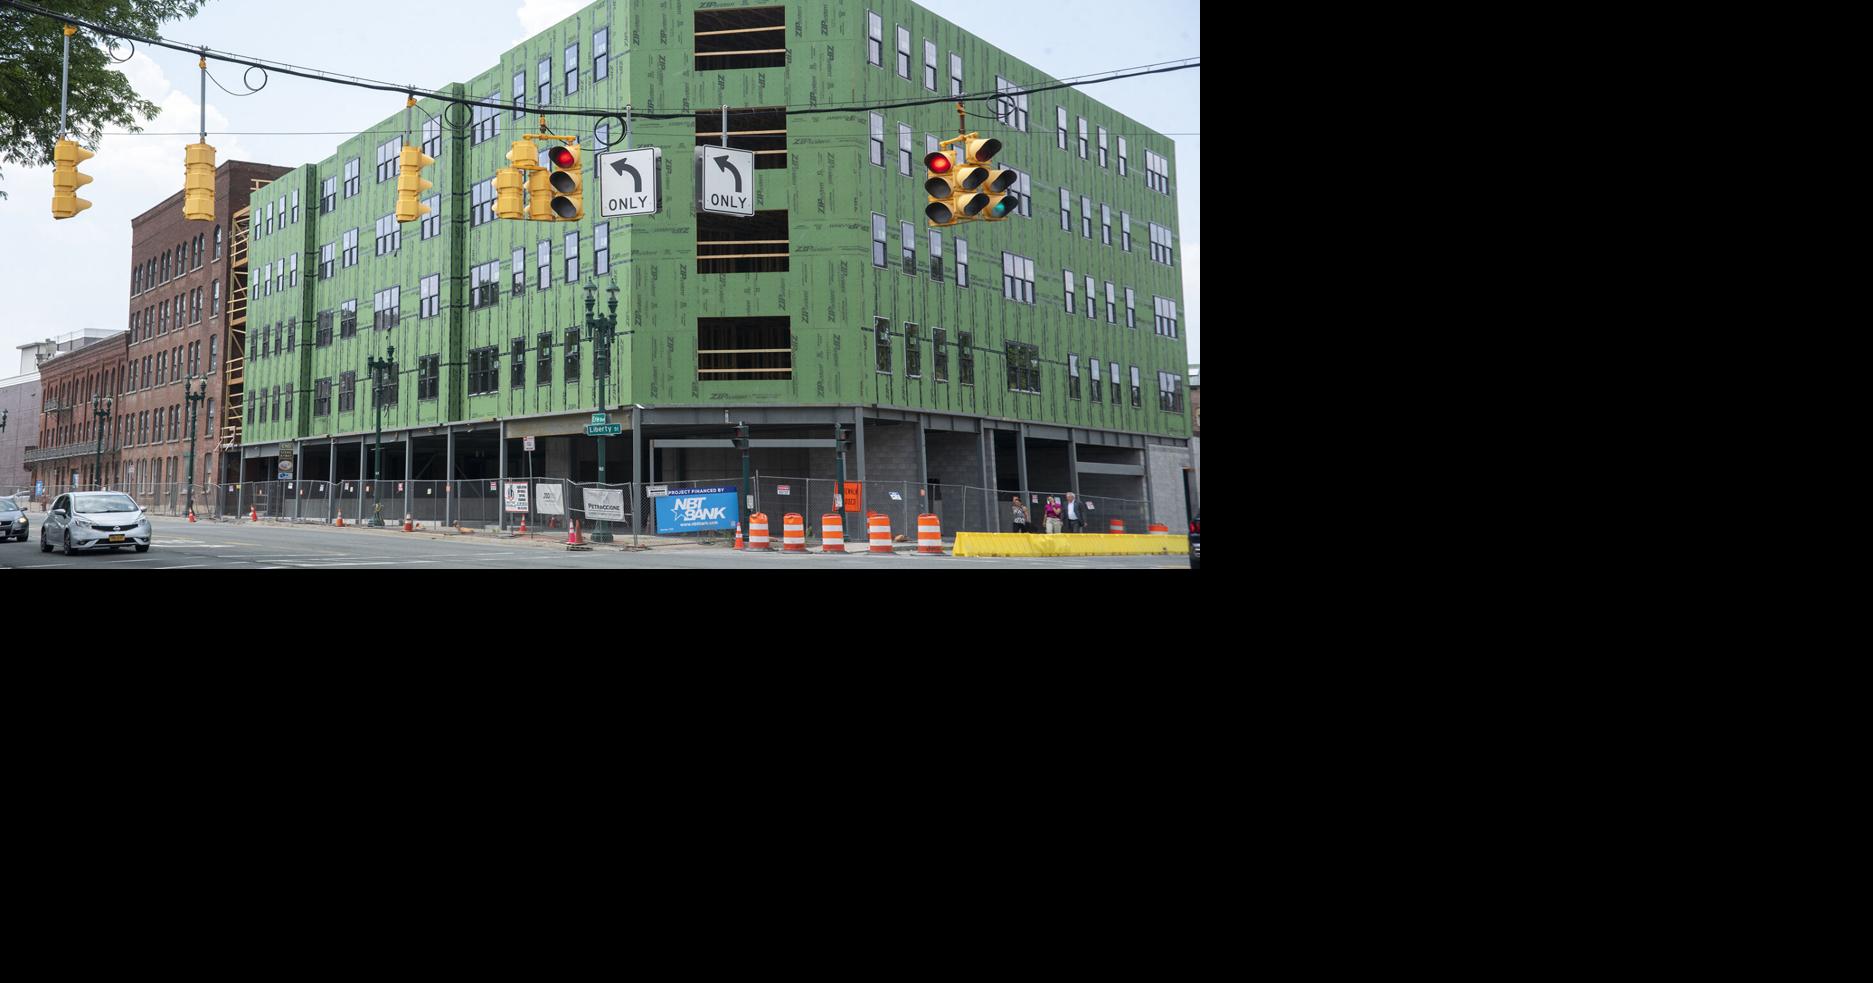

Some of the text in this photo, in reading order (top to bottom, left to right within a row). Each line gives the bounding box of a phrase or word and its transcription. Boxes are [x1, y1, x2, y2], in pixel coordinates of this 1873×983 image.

[608, 195, 648, 212] ONLY
[711, 193, 747, 209] ONLY
[674, 497, 707, 510] NBT
[683, 506, 727, 522] BANK
